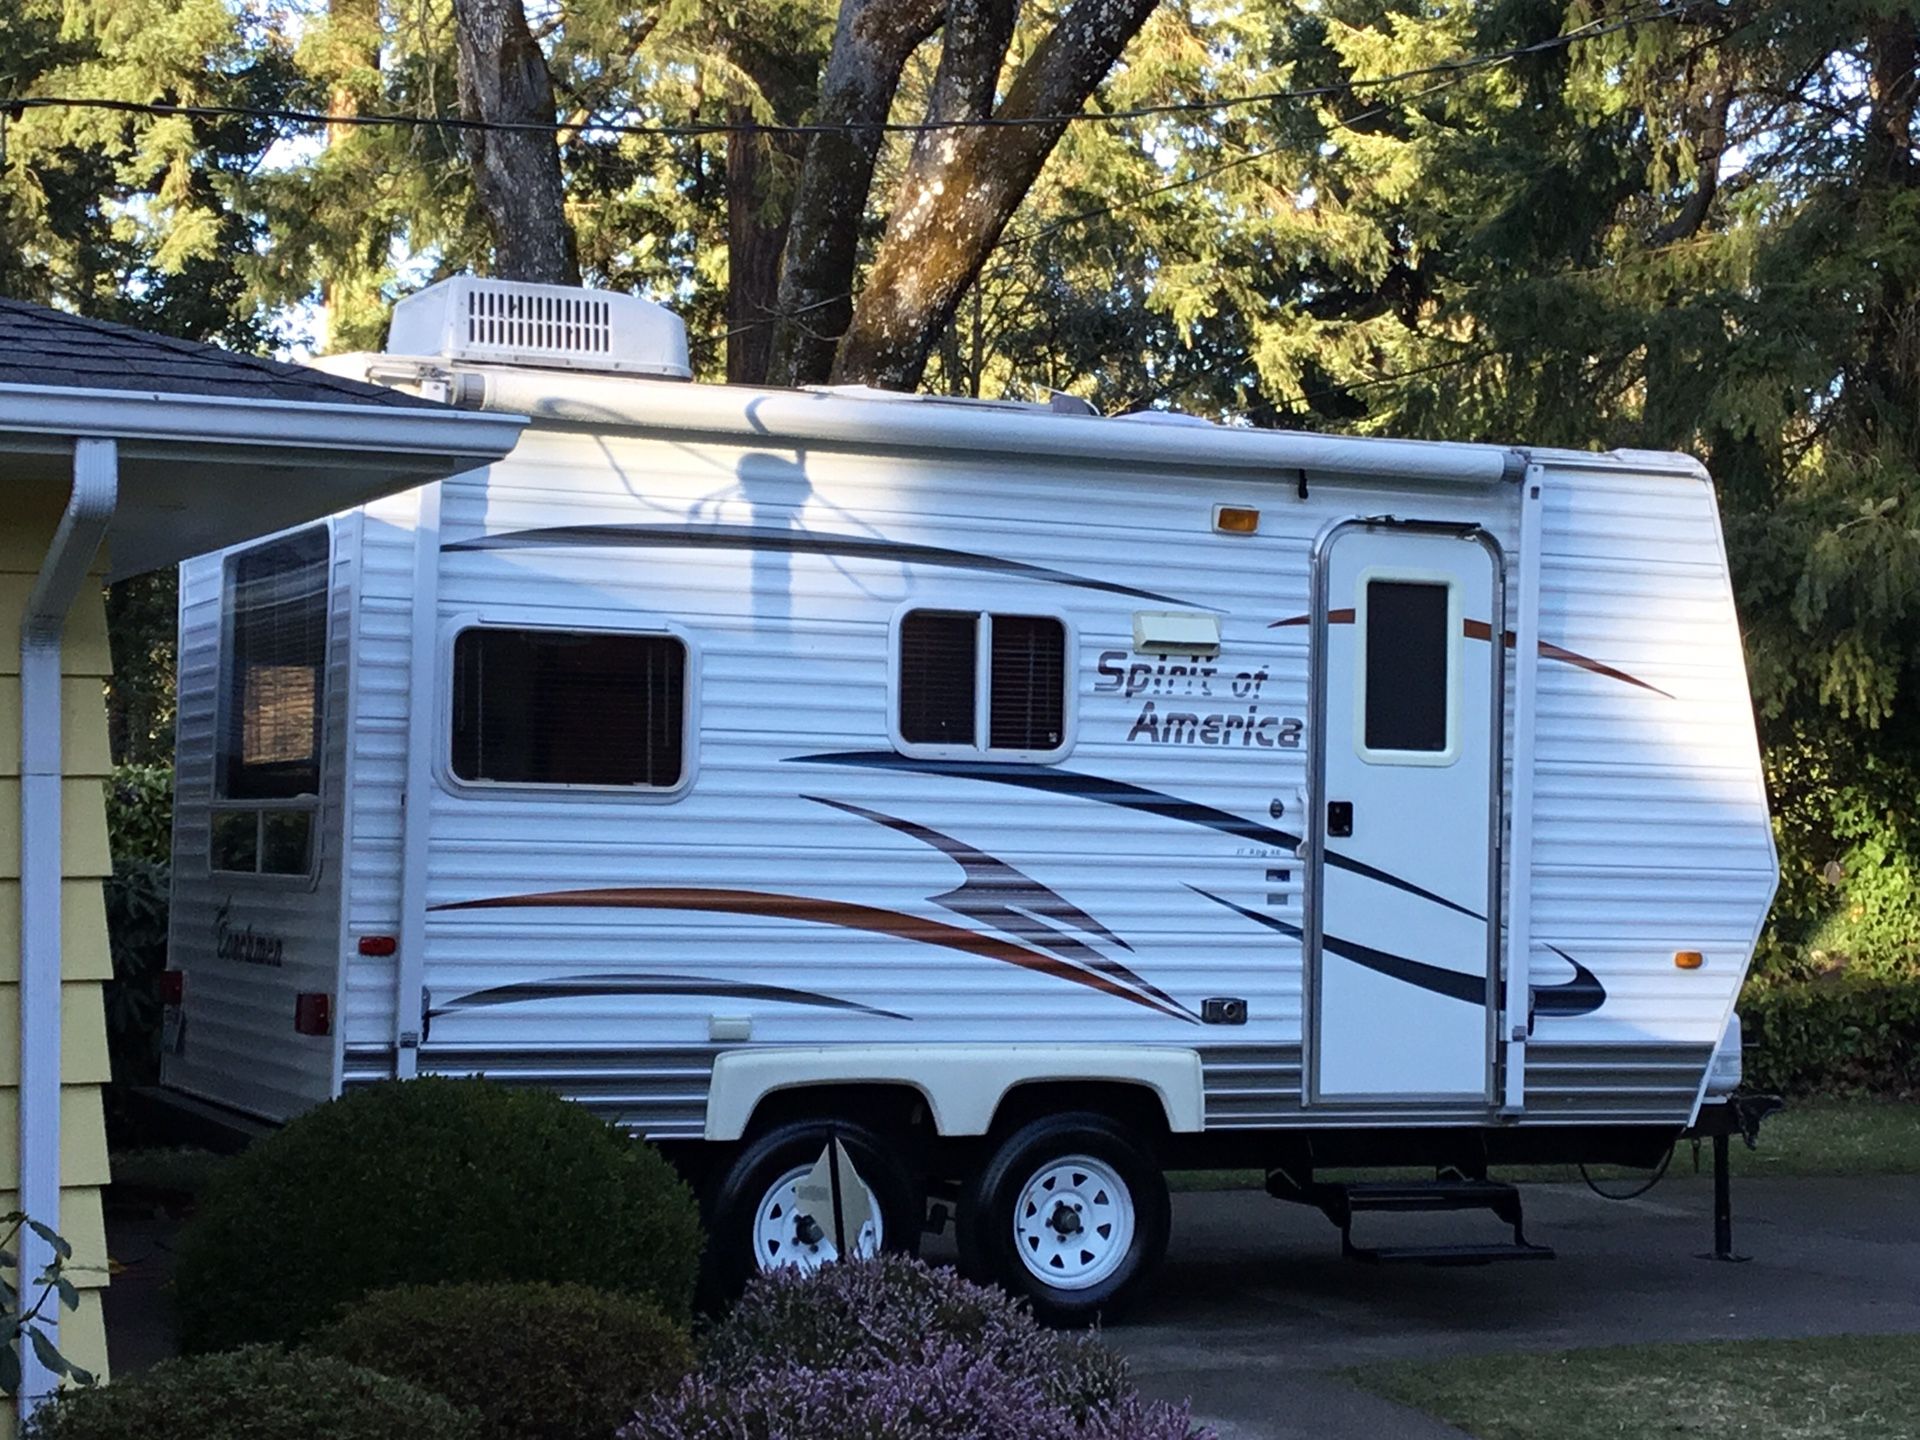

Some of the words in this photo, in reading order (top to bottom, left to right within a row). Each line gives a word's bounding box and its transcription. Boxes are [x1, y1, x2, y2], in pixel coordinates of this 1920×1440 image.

[1094, 651, 1218, 698] Spirit
[1232, 665, 1269, 699] of
[1127, 701, 1303, 748] America
